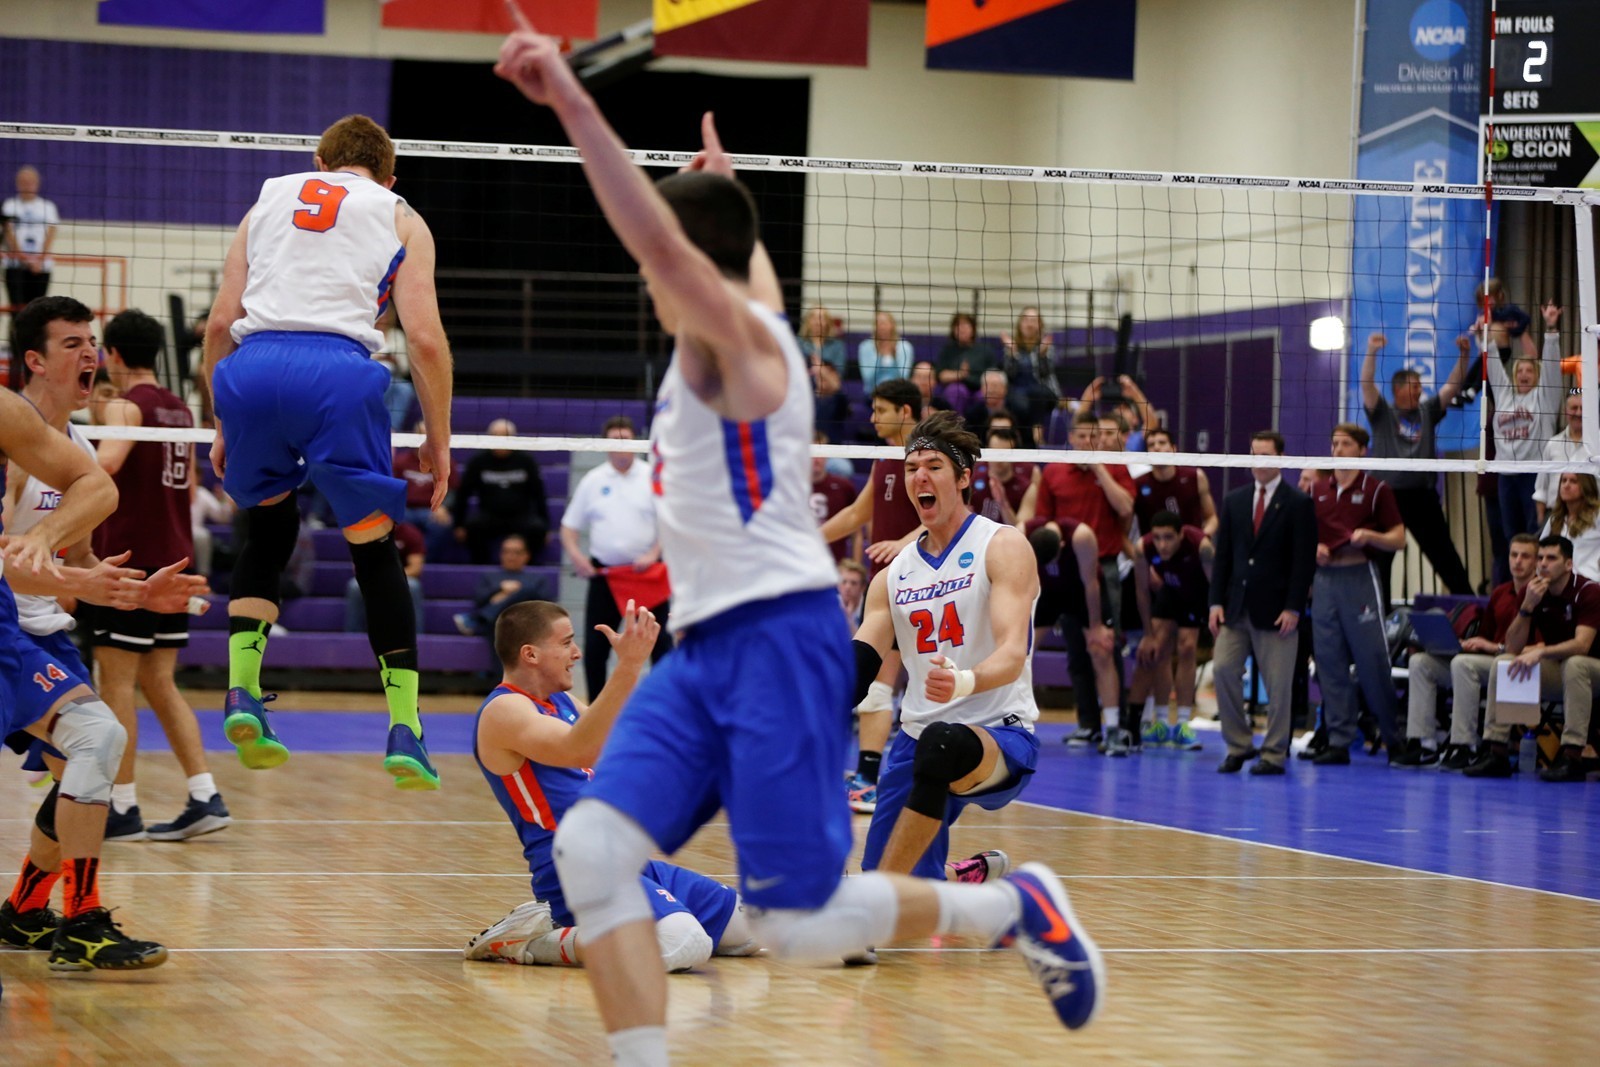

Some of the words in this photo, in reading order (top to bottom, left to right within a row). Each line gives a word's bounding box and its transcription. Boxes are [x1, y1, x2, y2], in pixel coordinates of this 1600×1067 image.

[1415, 26, 1466, 46] NCAA
[1515, 16, 1554, 33] FOULS
[1399, 63, 1458, 82] Division
[1523, 41, 1548, 82] 2
[1503, 91, 1539, 109] SETS
[509, 147, 533, 155] NCAA
[1512, 141, 1571, 158] SCION
[645, 153, 670, 161] NCAA
[779, 159, 804, 167] NCAA
[912, 164, 937, 173] NCAA
[1043, 170, 1067, 178] NCAA
[1172, 175, 1195, 183] NCAA
[1298, 180, 1321, 188] NCAA
[1422, 185, 1445, 193] NCAA
[292, 179, 349, 233] 9
[884, 473, 896, 502] 7
[909, 601, 964, 654] 24
[33, 663, 69, 692] 14
